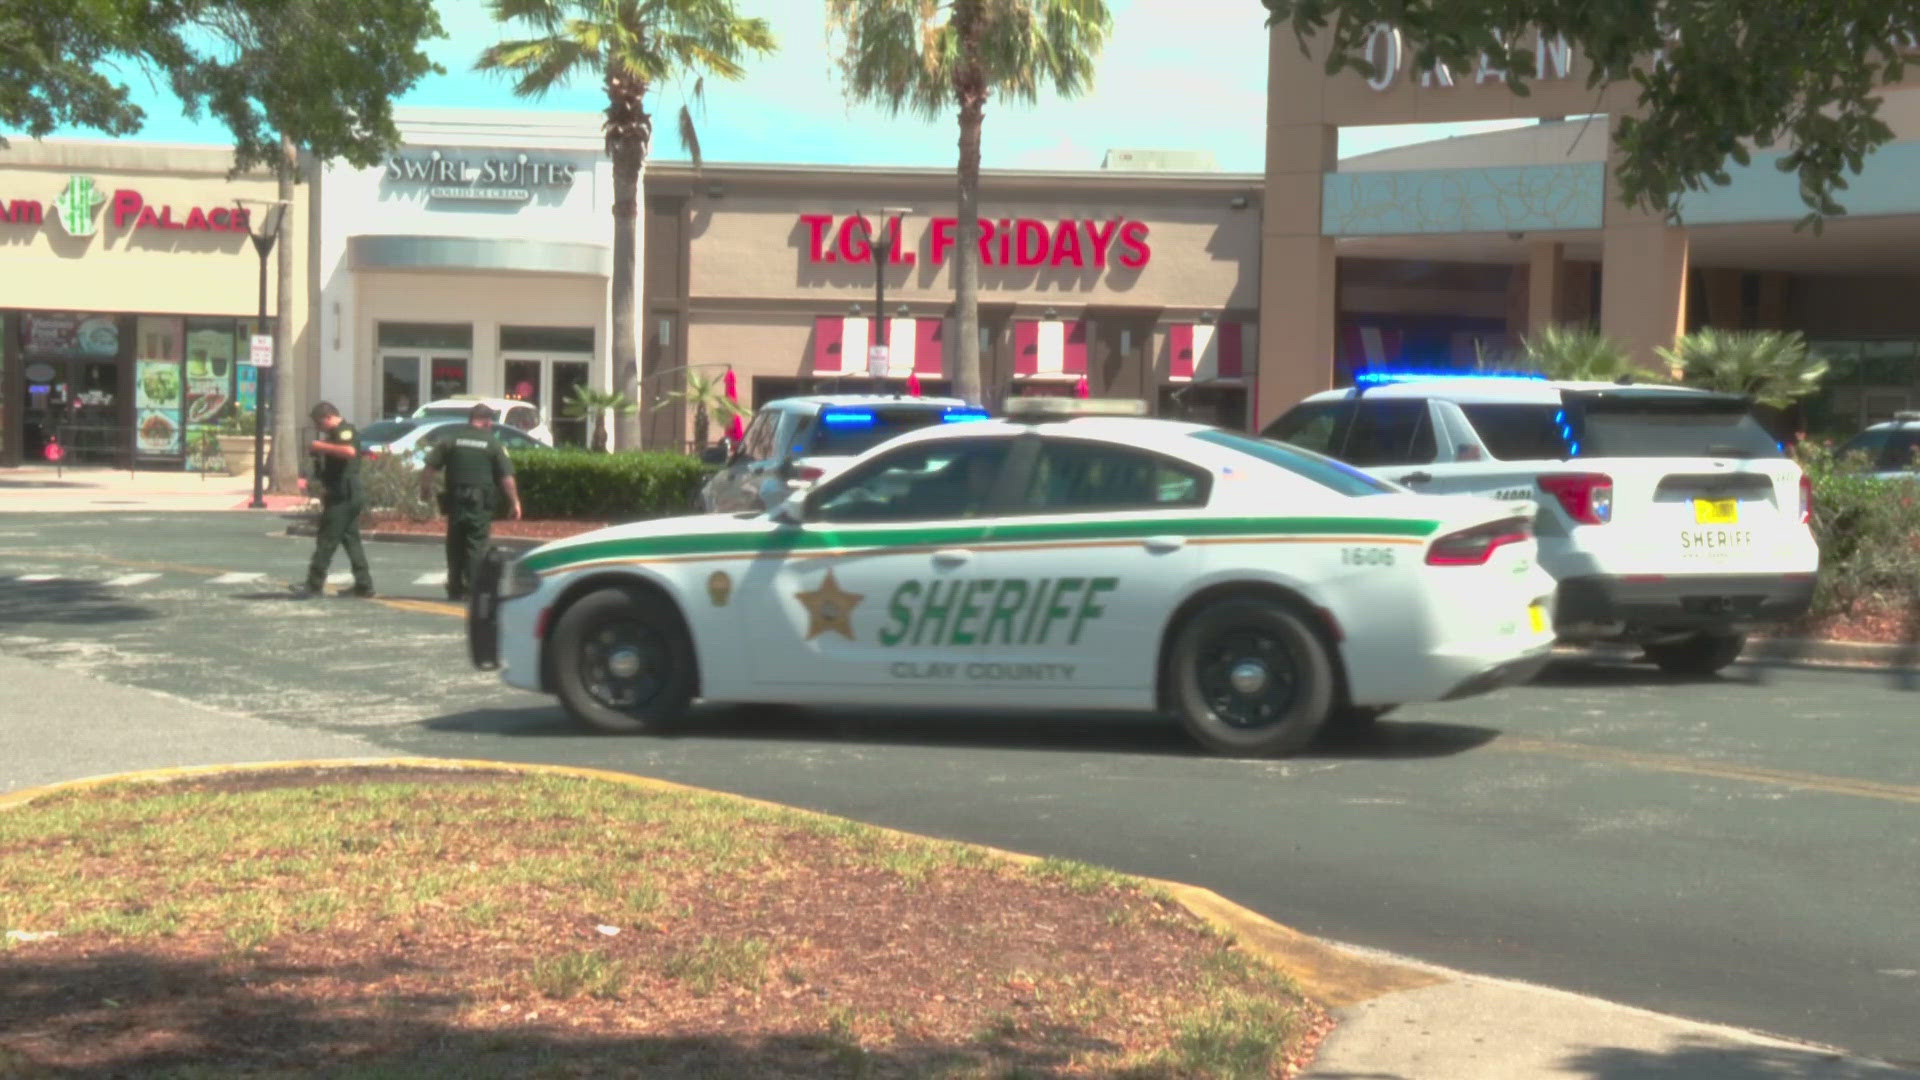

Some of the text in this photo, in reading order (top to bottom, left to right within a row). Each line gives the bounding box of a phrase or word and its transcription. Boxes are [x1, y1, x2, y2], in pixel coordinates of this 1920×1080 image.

[388, 150, 575, 186] SWIRL SUITES
[113, 188, 251, 233] PALACE
[1681, 530, 1752, 549] SHERIFF
[1341, 547, 1396, 567] 1606
[878, 576, 1120, 647] SHERIFF
[890, 661, 1077, 682] CLAY COUNTY
